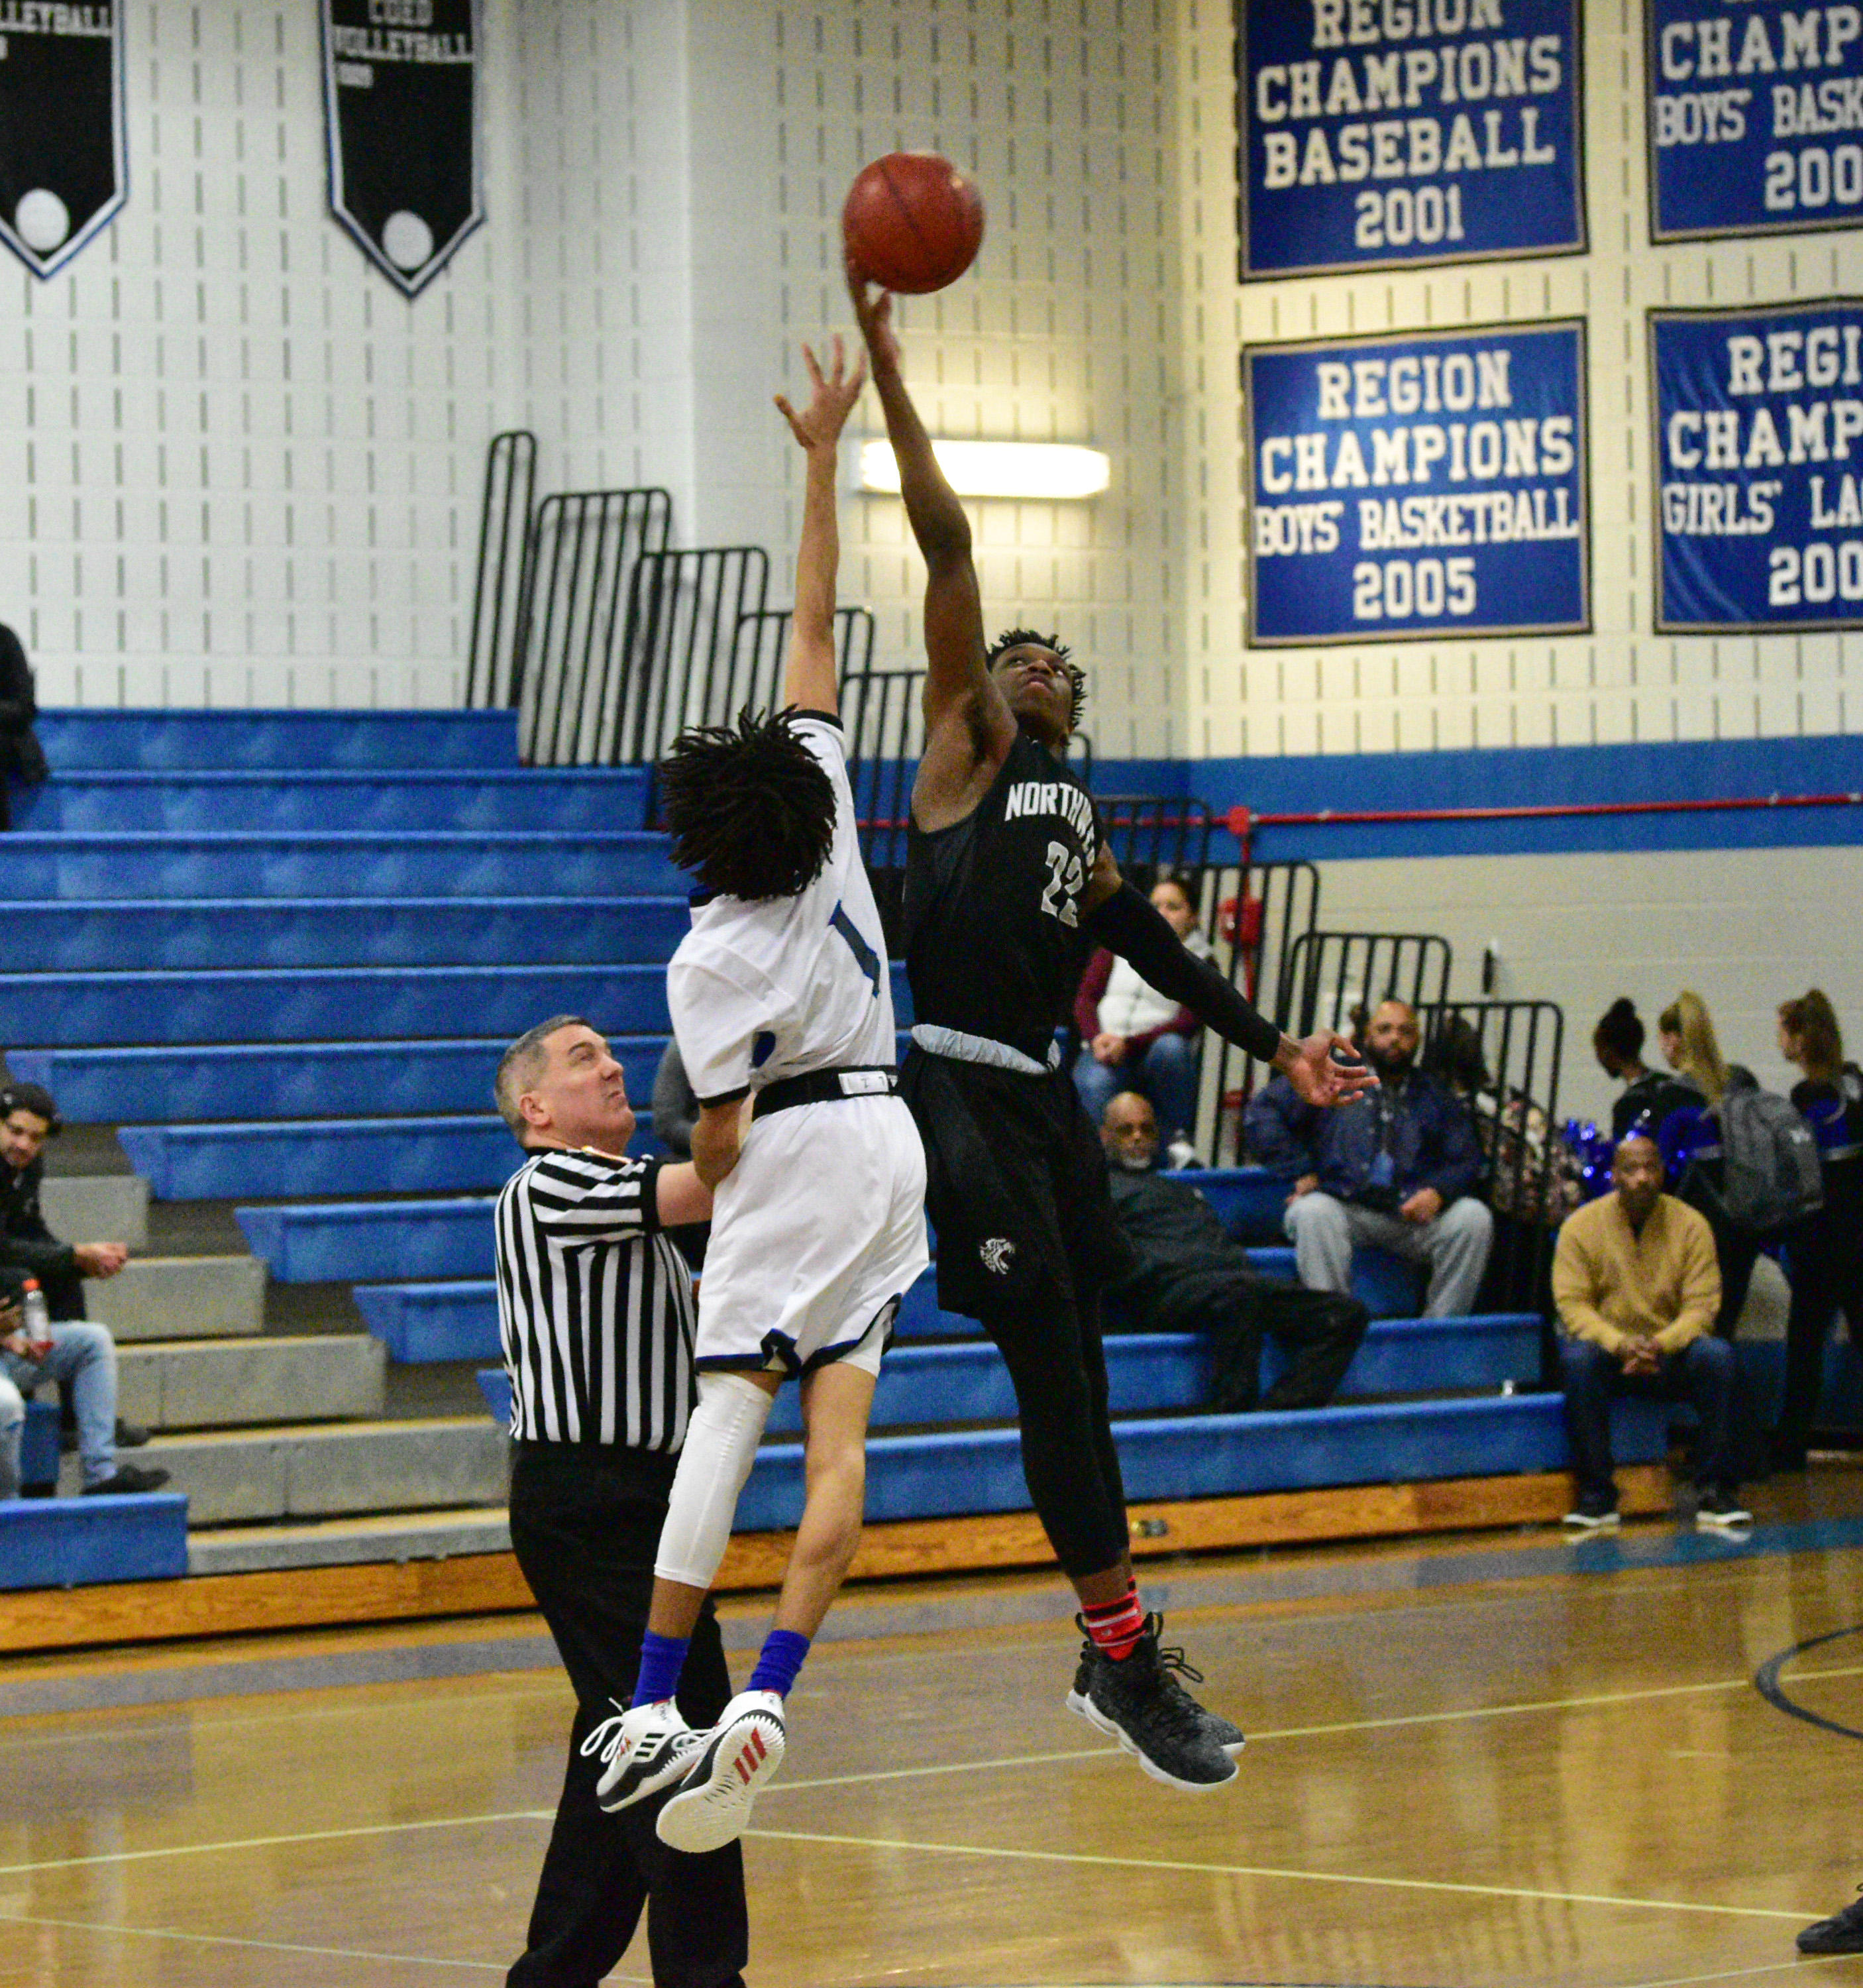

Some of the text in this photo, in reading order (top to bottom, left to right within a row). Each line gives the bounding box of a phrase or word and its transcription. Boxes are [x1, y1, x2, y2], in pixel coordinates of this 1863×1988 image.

[1312, 0, 1504, 49] REGION
[1661, 5, 1862, 80] CHAMP
[1257, 35, 1562, 123] CHAMPIONS
[1263, 107, 1556, 190] BASEBALL
[1764, 144, 1863, 211] 200
[1355, 184, 1465, 248] 2001
[1316, 350, 1512, 420] REGION
[1727, 325, 1861, 395] REGI
[1261, 416, 1575, 494] CHAMPIONS
[1668, 399, 1863, 470] CHAMP
[1358, 488, 1579, 551] BASKETBALL
[1809, 472, 1863, 529] LA
[1352, 557, 1477, 620] 2005
[1768, 540, 1863, 606] 200
[1041, 840, 1083, 928] 22
